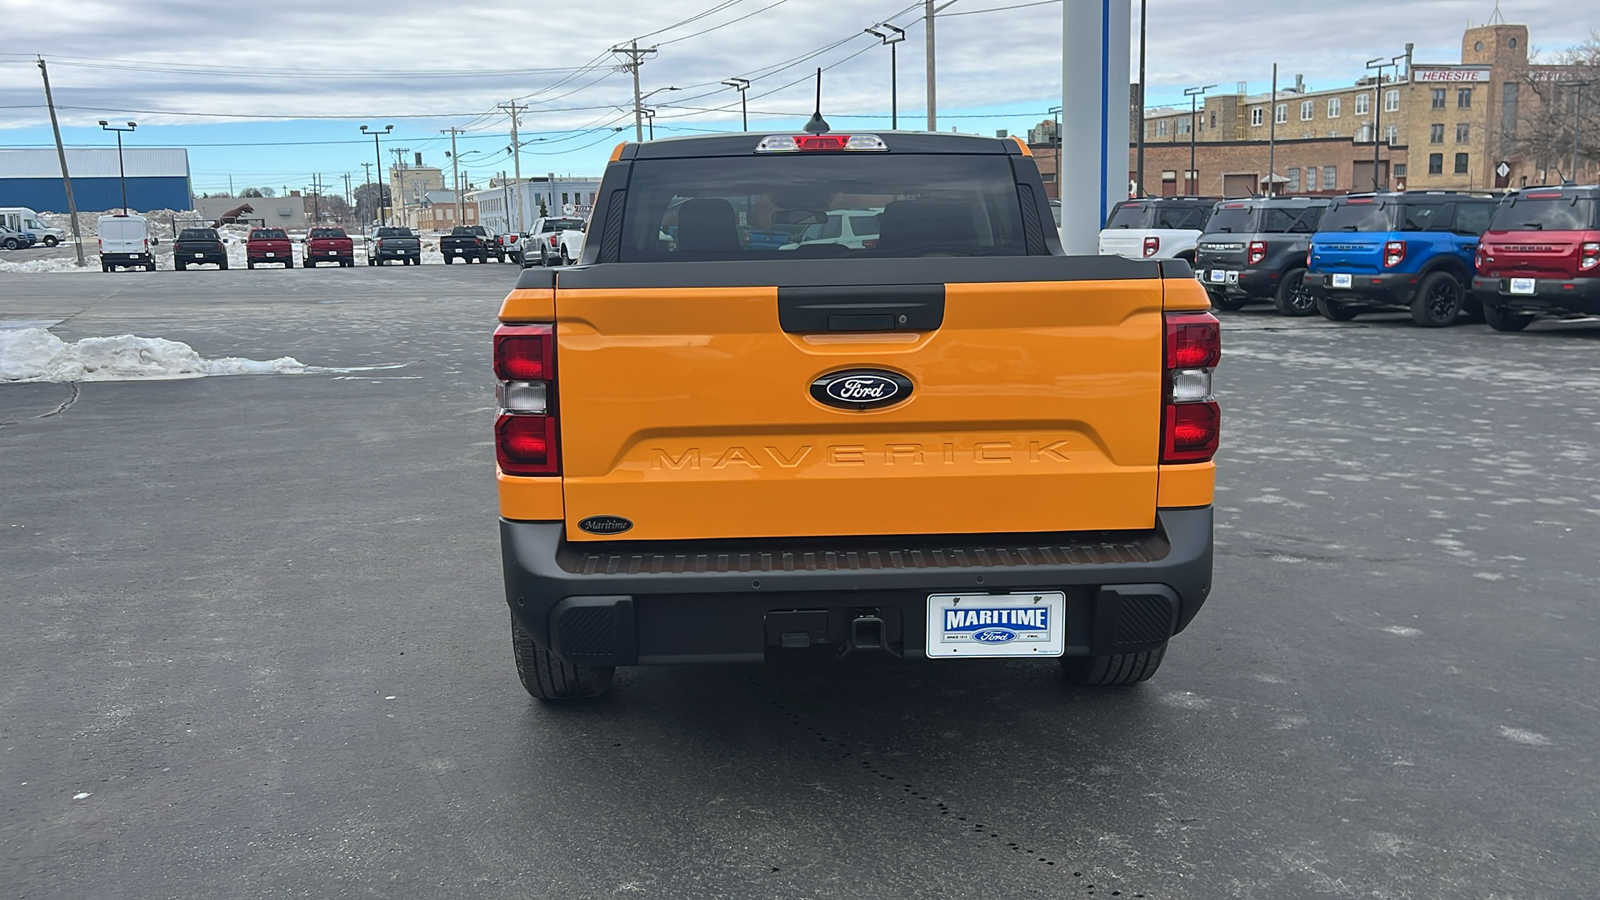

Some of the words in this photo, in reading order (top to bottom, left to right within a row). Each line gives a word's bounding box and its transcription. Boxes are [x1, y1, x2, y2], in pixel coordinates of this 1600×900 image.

[1422, 71, 1480, 81] HERESITE
[840, 379, 885, 398] Ford
[650, 439, 1071, 471] MAVERICK
[585, 520, 628, 530] Maritime
[946, 609, 1046, 630] MARITIME
[980, 630, 1009, 642] Ford
